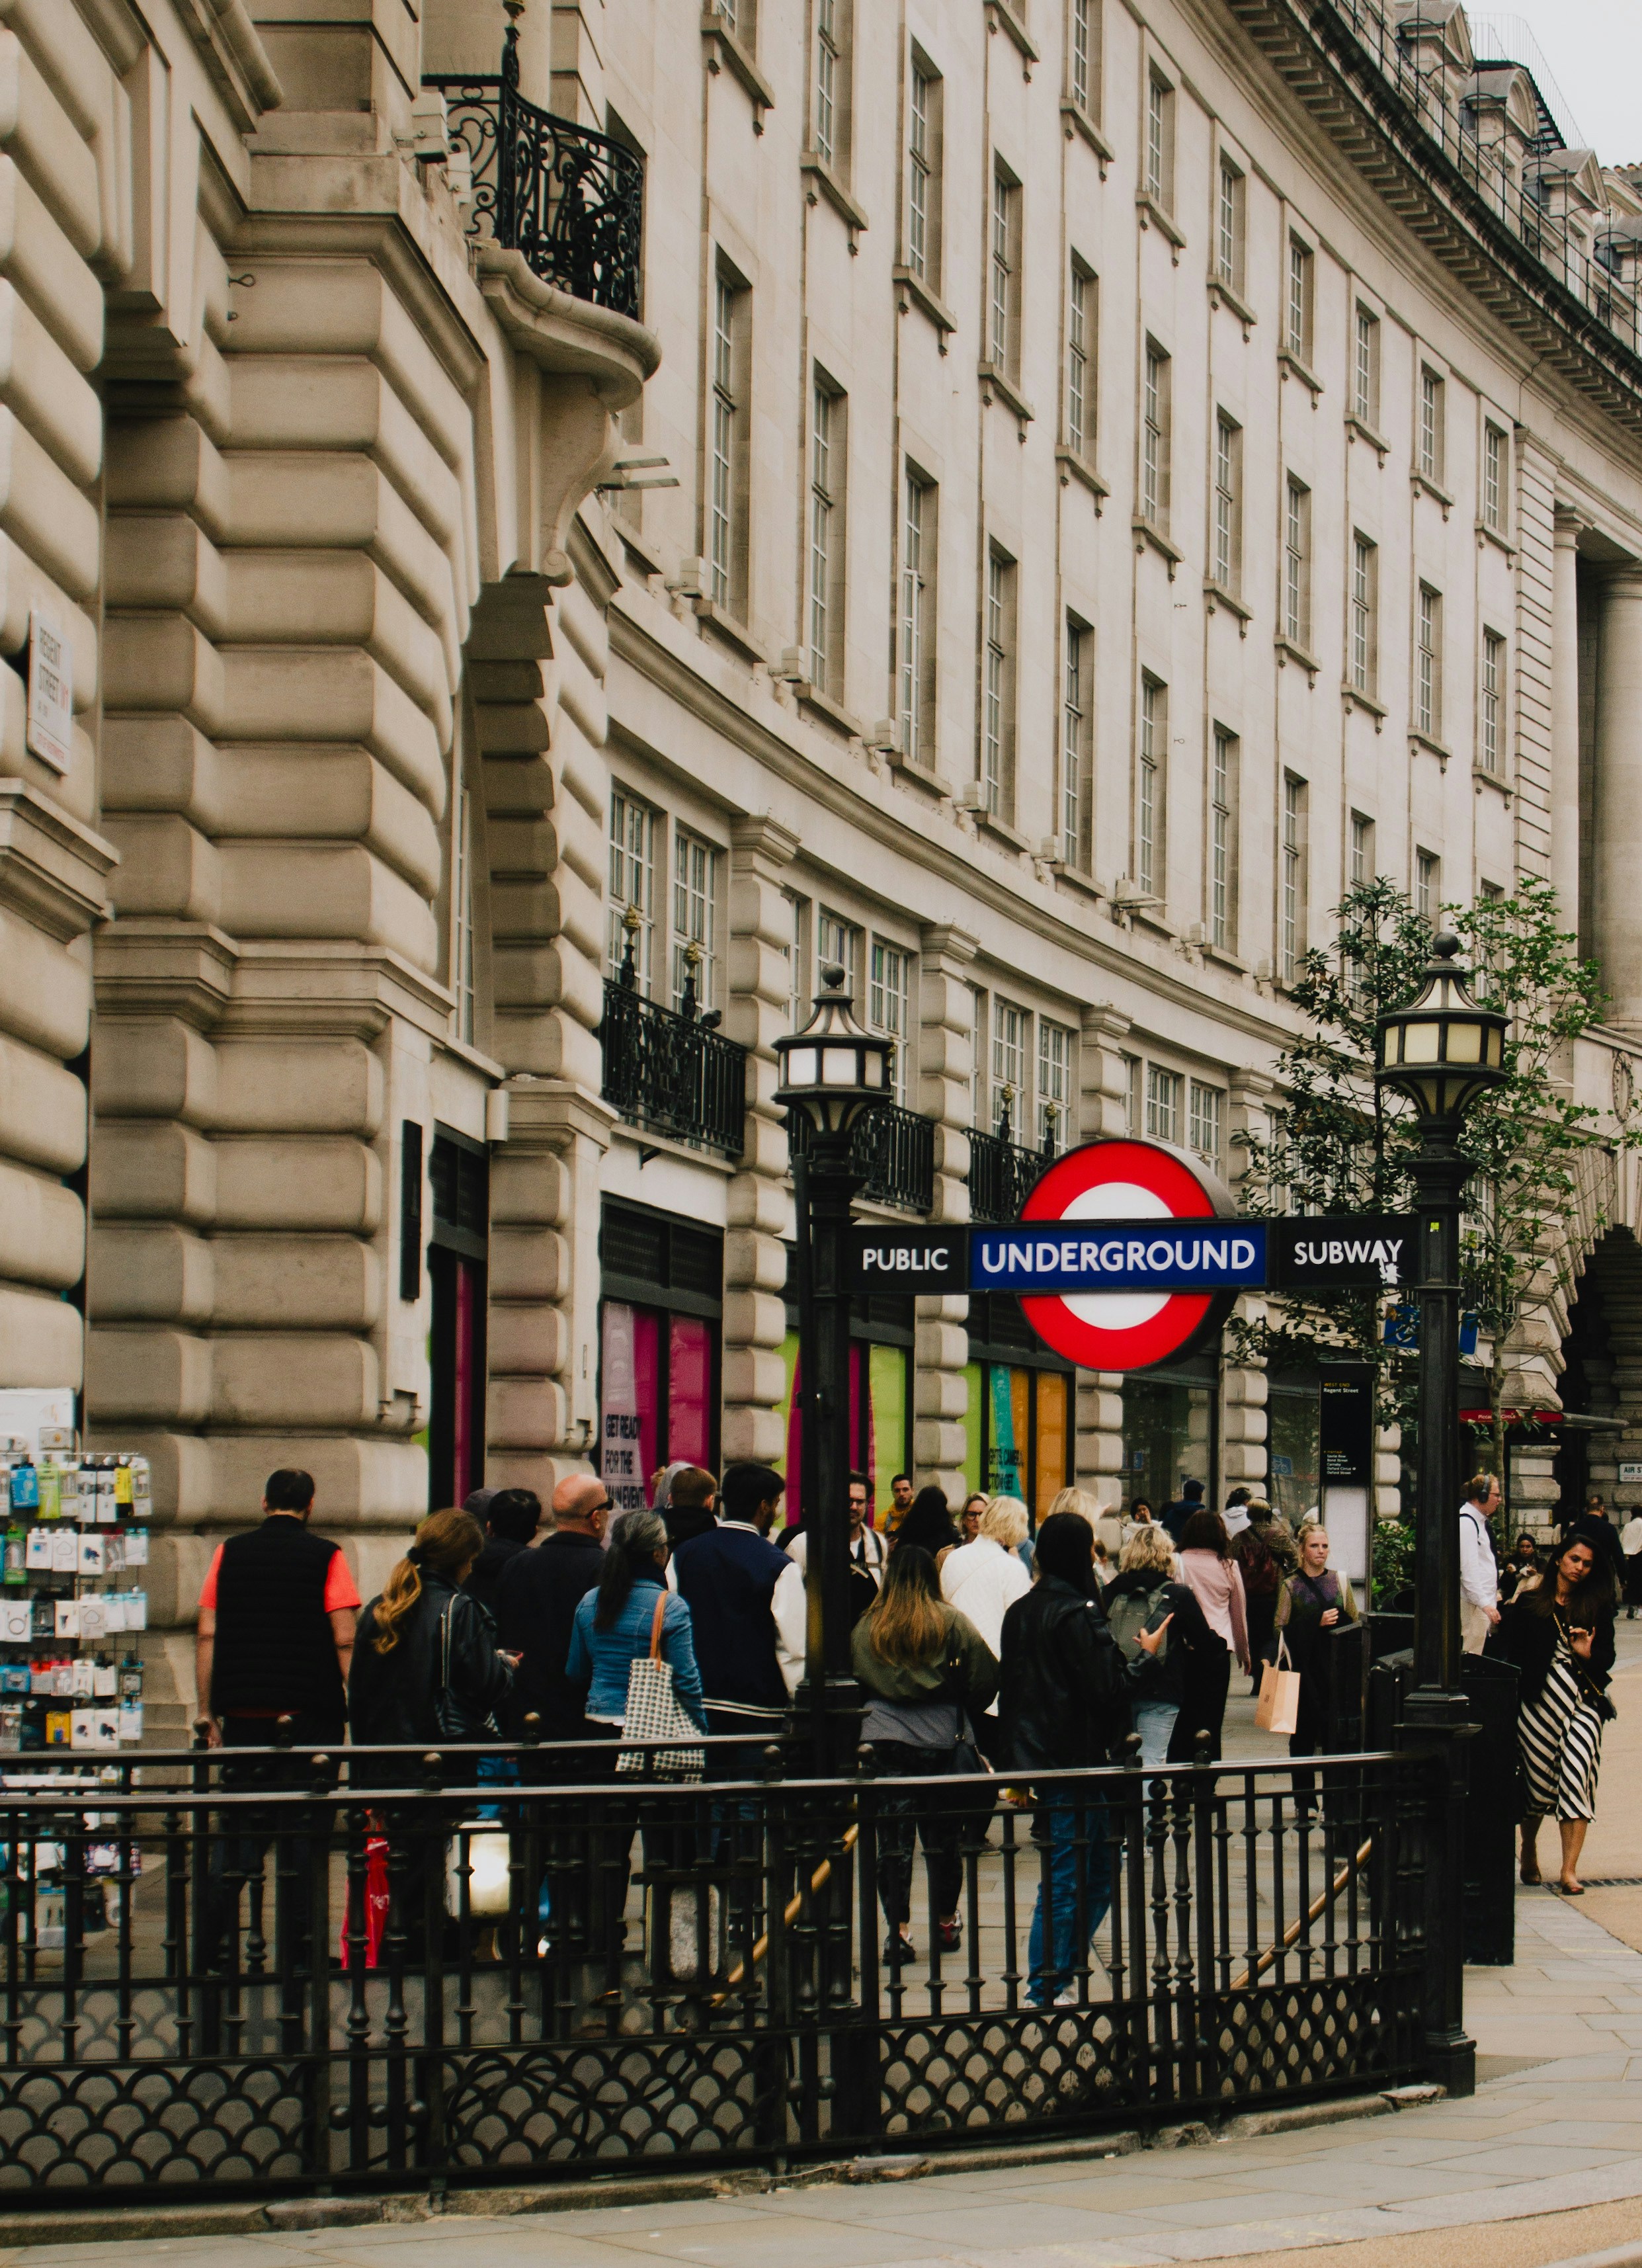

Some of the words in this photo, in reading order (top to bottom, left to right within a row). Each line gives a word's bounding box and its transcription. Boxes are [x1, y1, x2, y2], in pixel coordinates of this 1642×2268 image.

[862, 1248, 949, 1271] PUBLIC
[982, 1239, 1256, 1273] UNDERGROUND
[1293, 1239, 1403, 1265] SUBWAY
[606, 1413, 620, 1439] GET
[605, 1449, 619, 1474] FOR
[620, 1450, 633, 1474] THE
